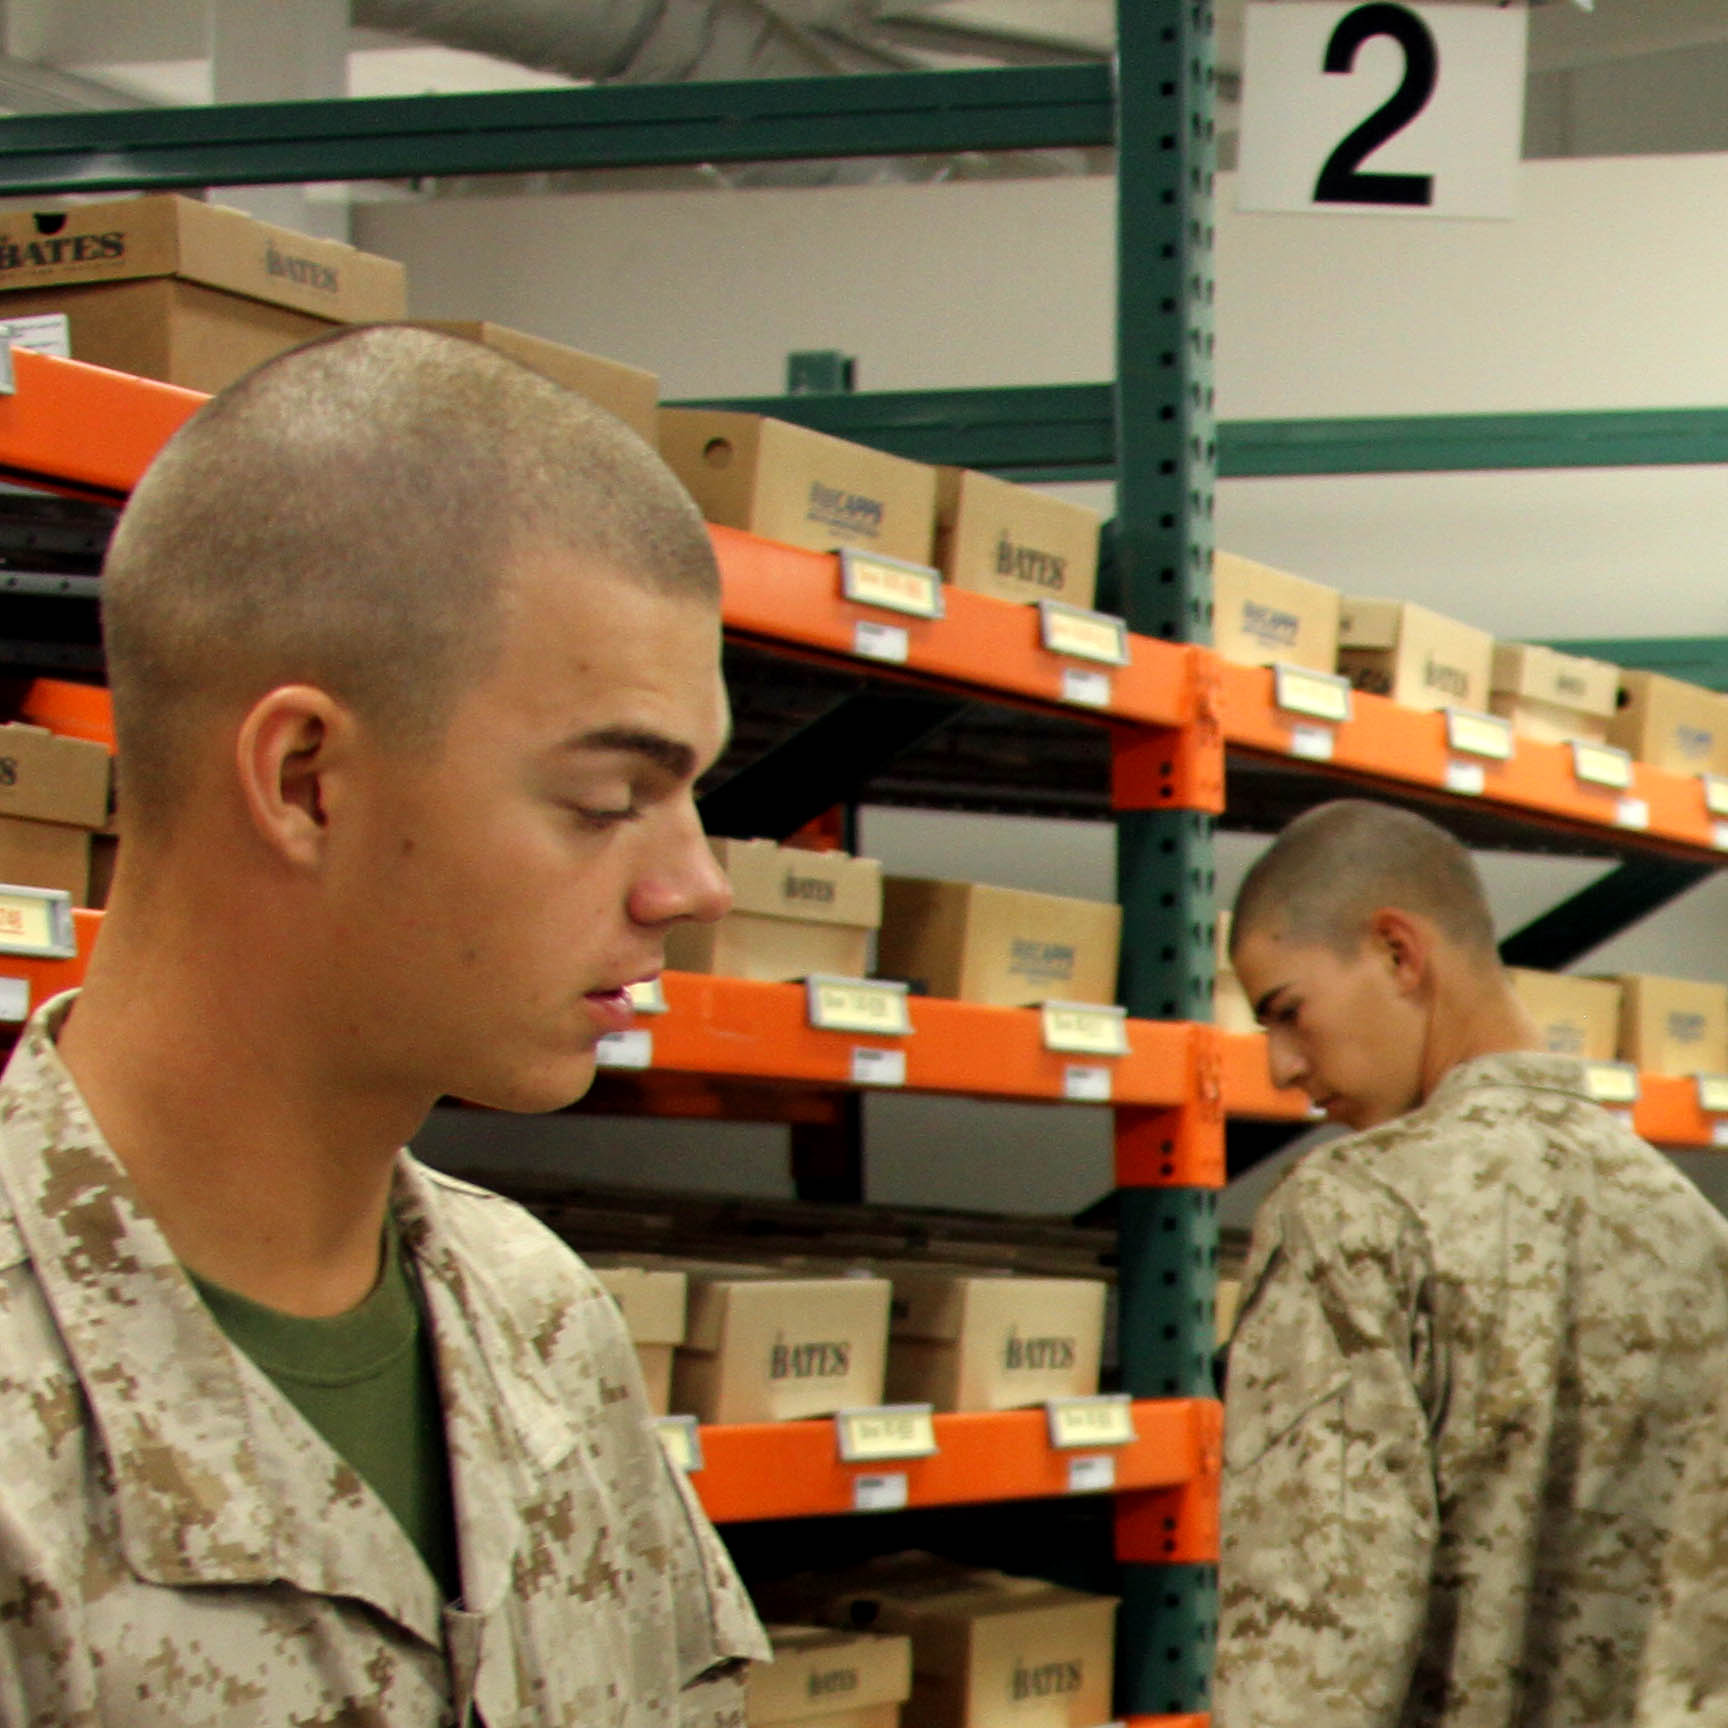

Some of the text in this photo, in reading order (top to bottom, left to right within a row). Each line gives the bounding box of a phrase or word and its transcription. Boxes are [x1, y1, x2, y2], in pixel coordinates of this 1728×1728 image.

[1312, 2, 1440, 206] 2
[264, 244, 339, 293] BATES
[996, 538, 1068, 592] BATES
[769, 1341, 851, 1380] BATES
[1003, 1336, 1076, 1371] BATES
[1011, 1660, 1083, 1702] BATES
